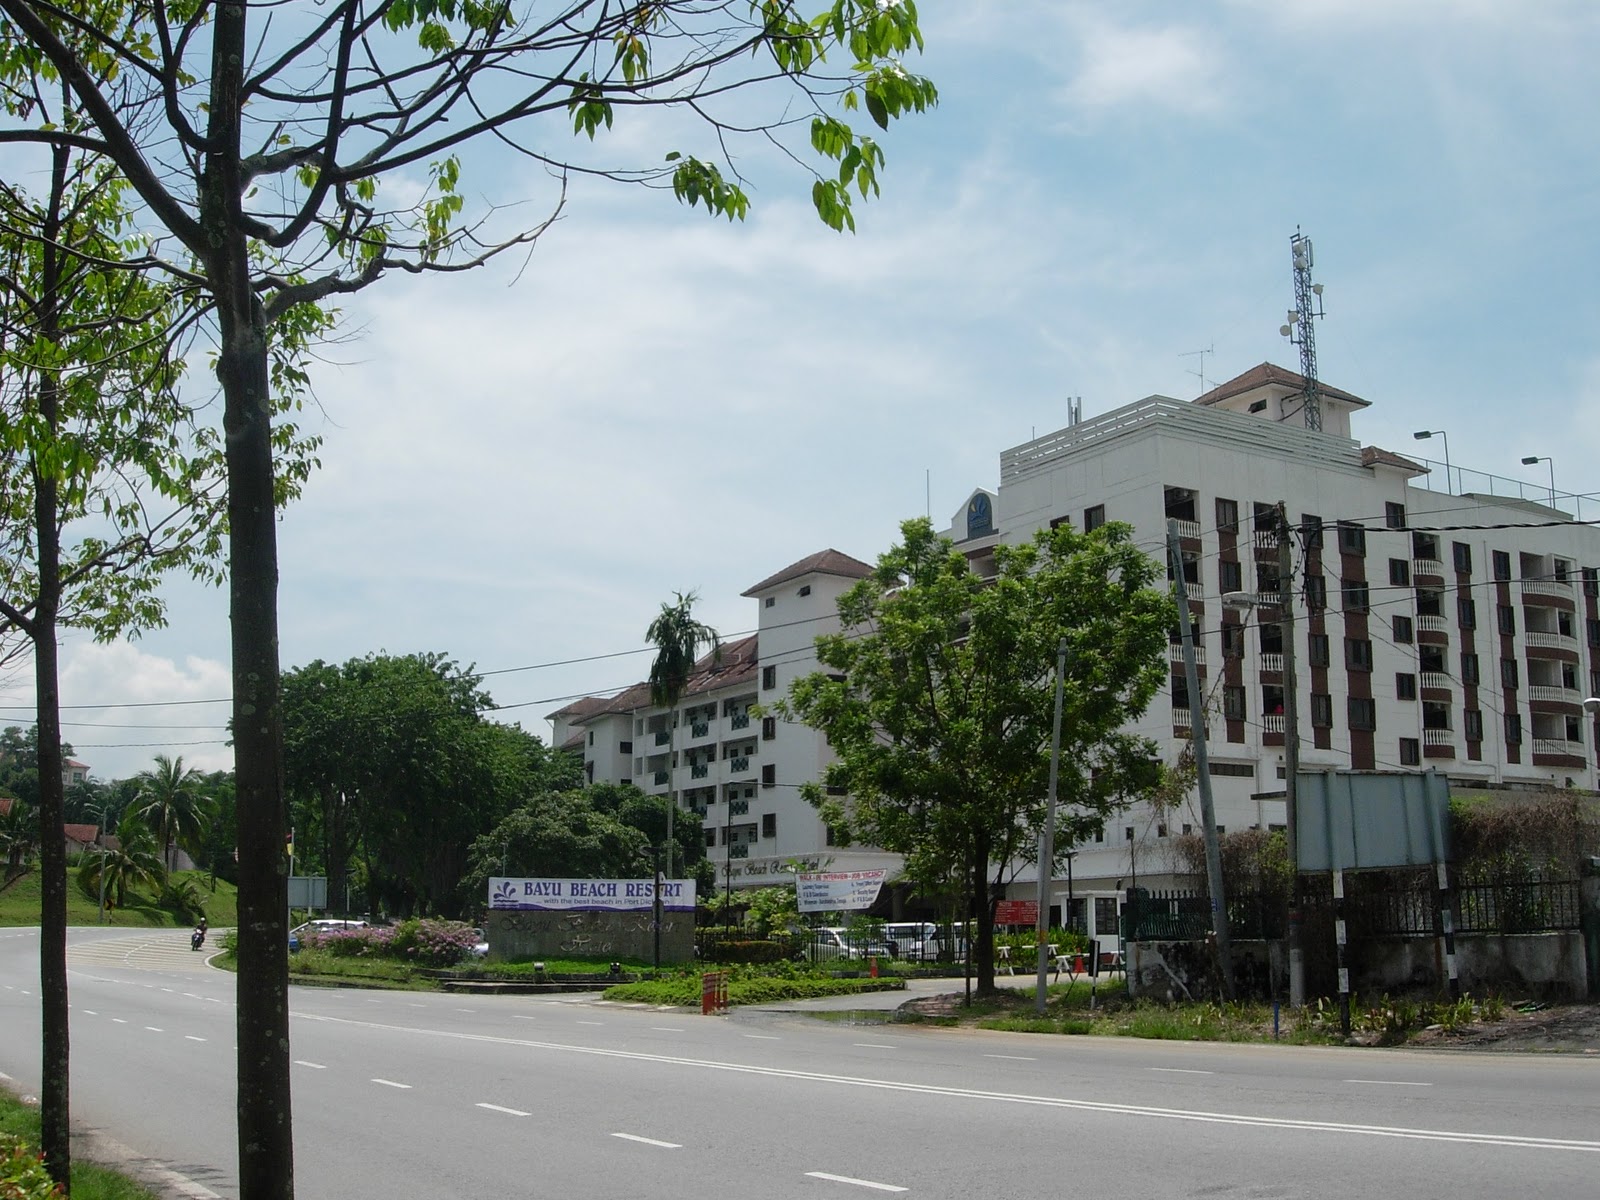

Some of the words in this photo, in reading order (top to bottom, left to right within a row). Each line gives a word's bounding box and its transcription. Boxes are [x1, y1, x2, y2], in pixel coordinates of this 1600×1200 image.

[524, 881, 562, 897] BAYU
[570, 882, 617, 897] BEACH
[625, 883, 682, 897] RESRT
